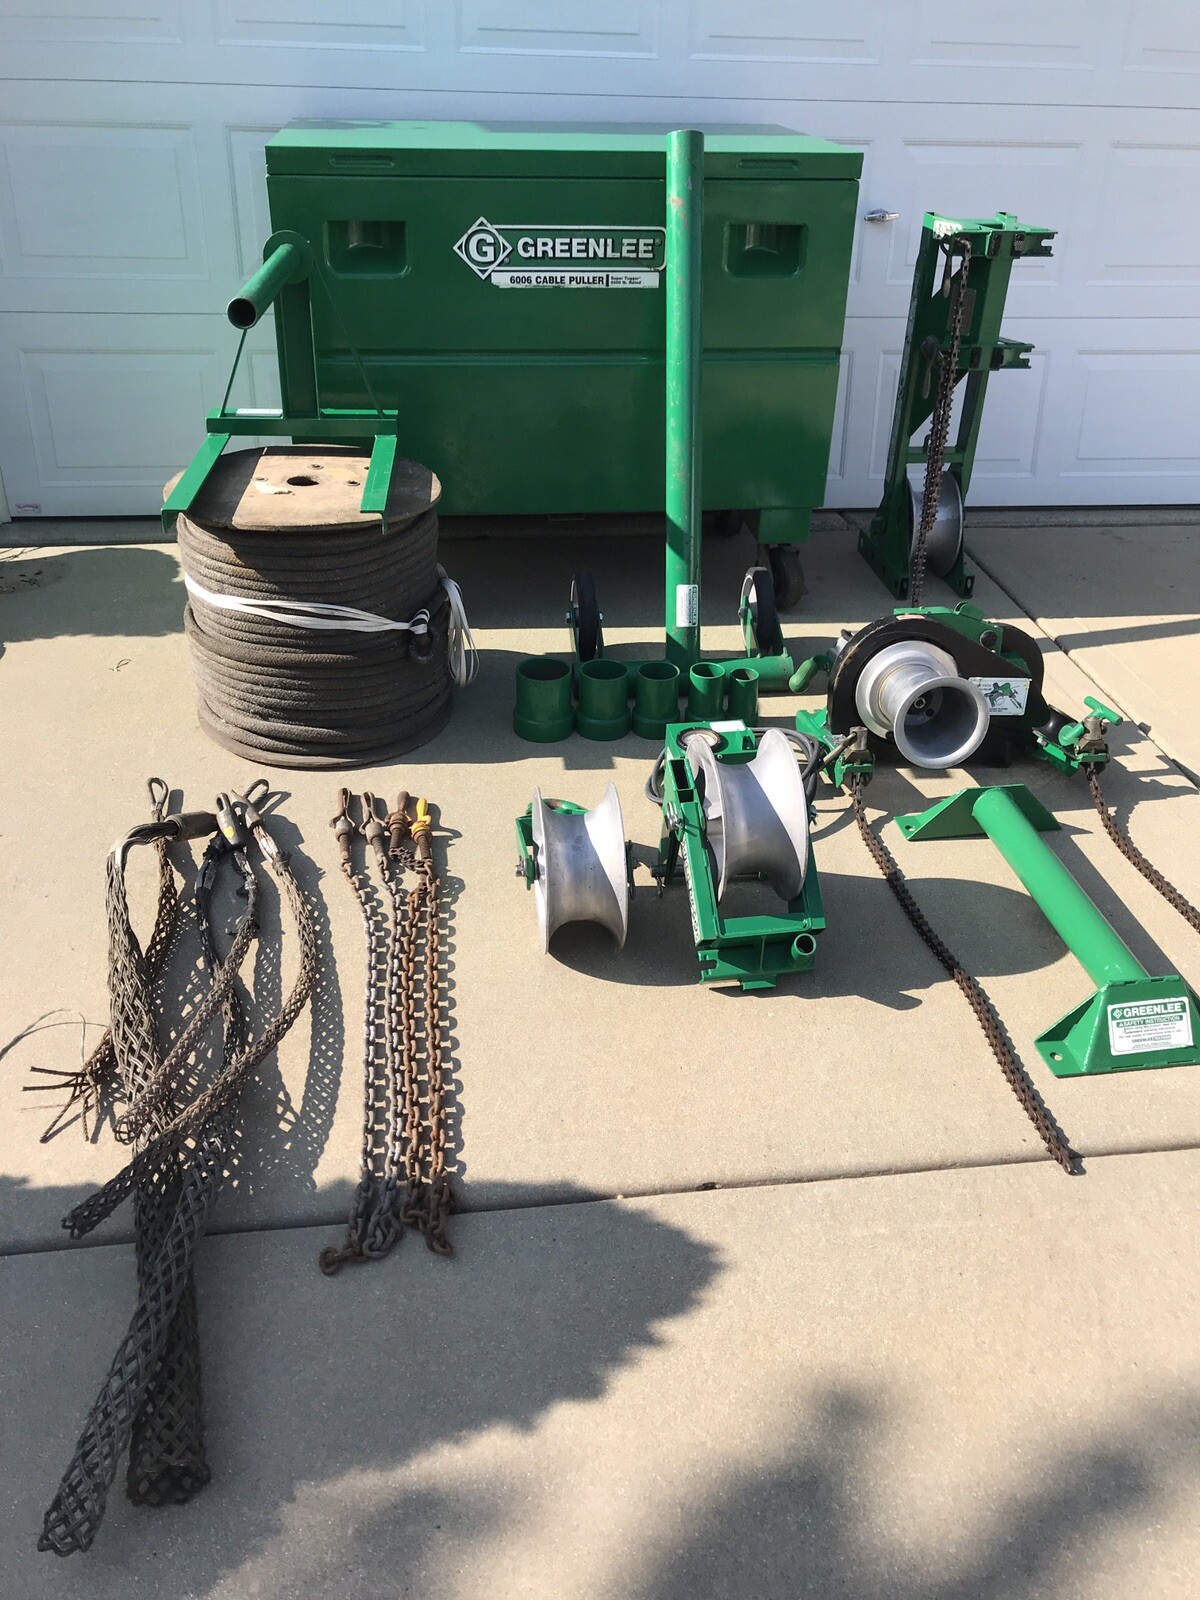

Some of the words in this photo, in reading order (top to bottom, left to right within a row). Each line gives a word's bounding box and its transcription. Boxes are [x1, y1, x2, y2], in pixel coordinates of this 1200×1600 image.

[468, 233, 495, 262] G
[517, 237, 654, 258] GREENLEE
[510, 275, 533, 285] 6006
[535, 275, 566, 285] CABLE
[569, 275, 605, 285] PULLER
[1123, 1002, 1182, 1017] GREENLEE
